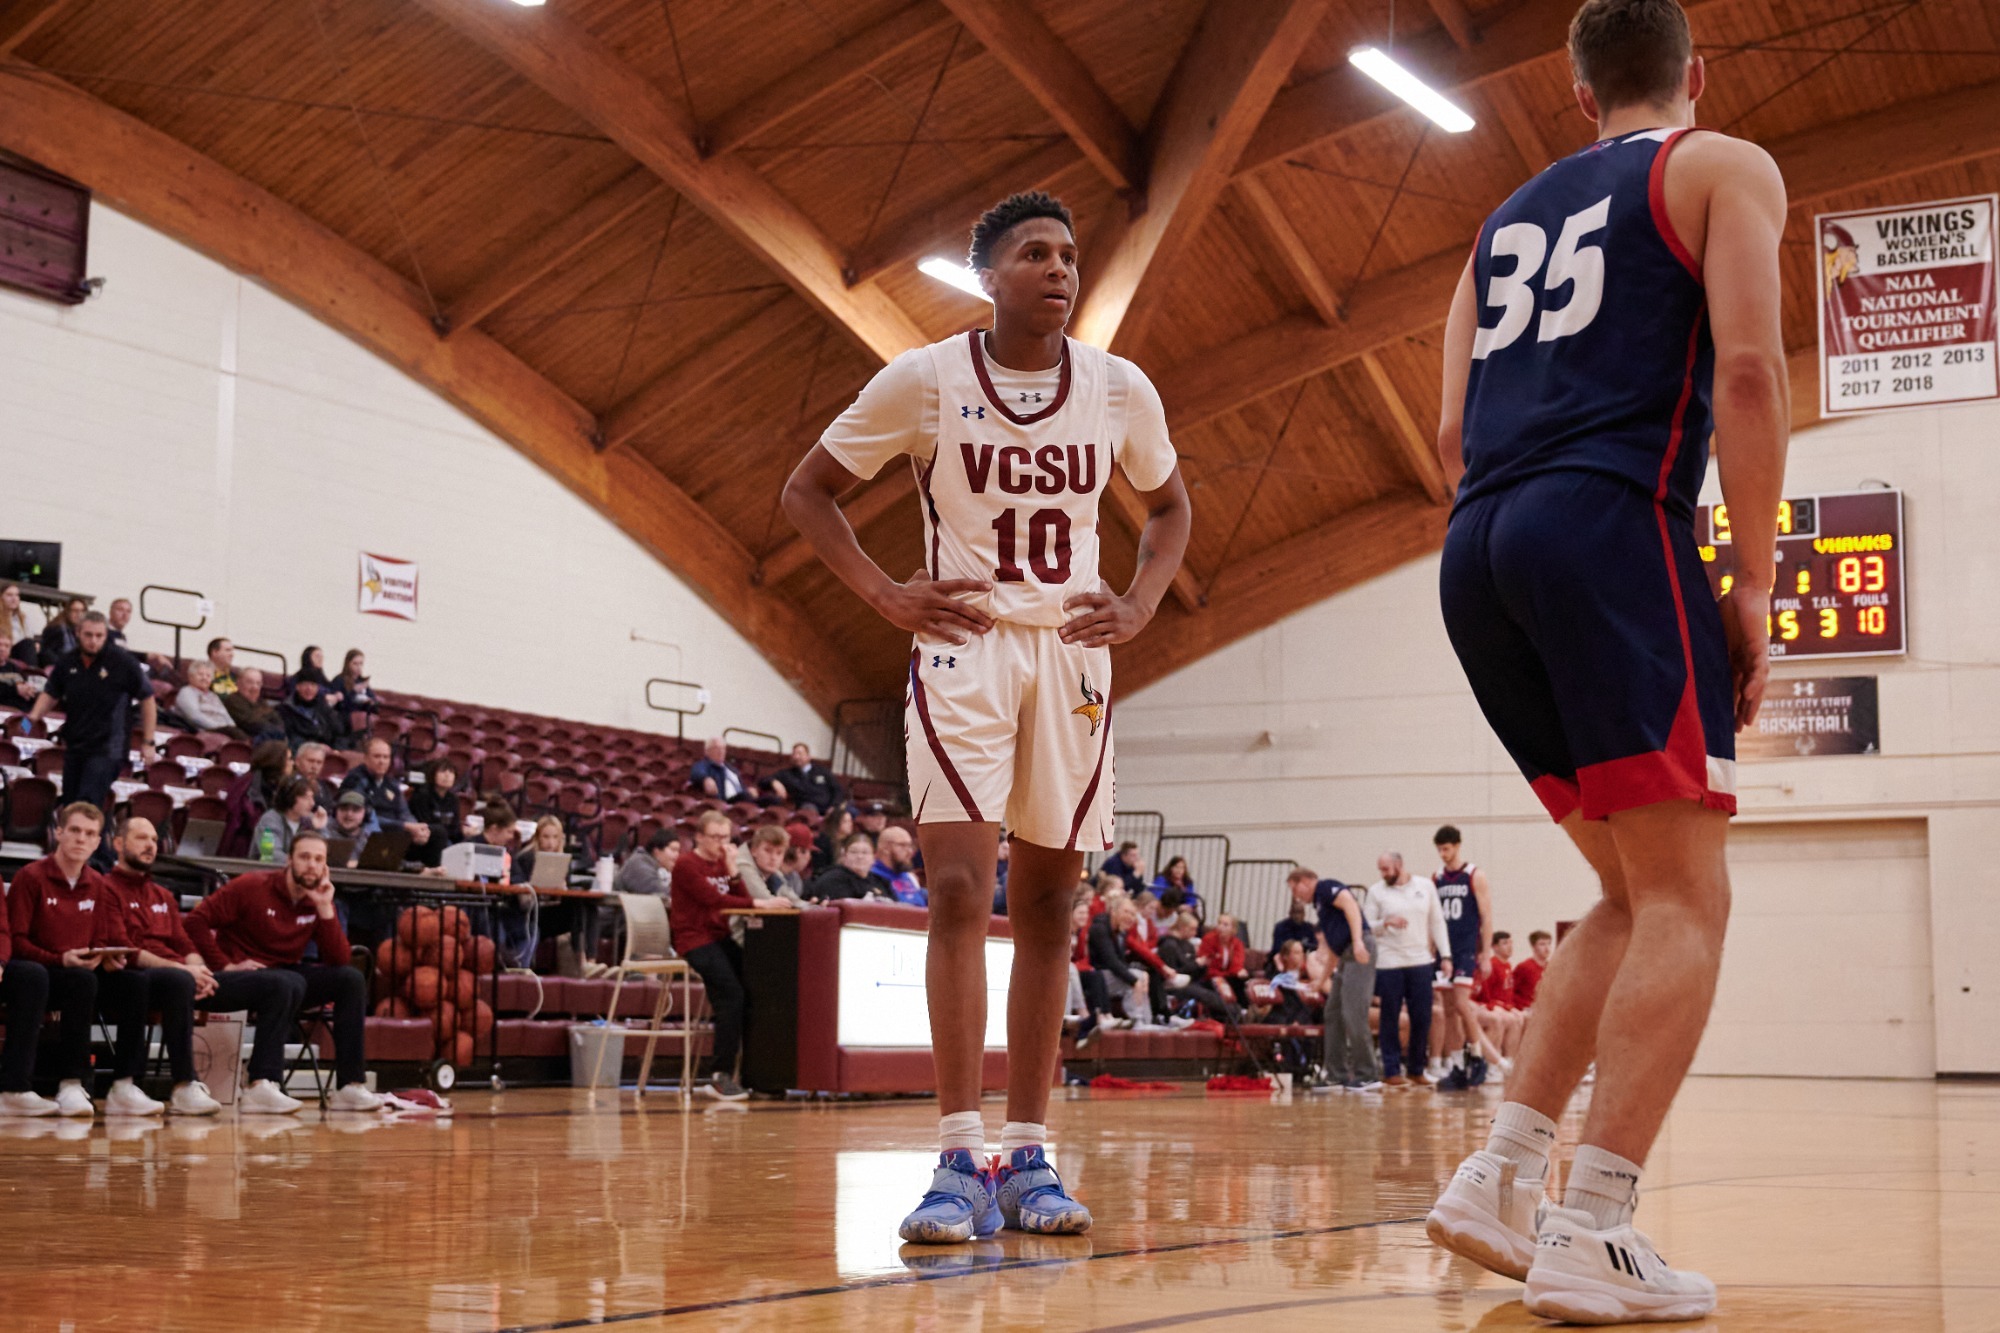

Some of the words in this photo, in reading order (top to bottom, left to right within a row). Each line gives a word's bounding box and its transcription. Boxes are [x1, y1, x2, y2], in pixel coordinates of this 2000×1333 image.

[1876, 209, 1975, 239] VIKINGS
[1886, 232, 1966, 250] WOMEN'S
[1877, 244, 1978, 267] BASKETBALL
[1471, 194, 1612, 360] 35
[1886, 273, 1936, 292] NAIA
[1861, 289, 1963, 312] NATIONAL
[1841, 304, 1983, 332] TOURNAMENT
[1858, 323, 1966, 349] QUALIFIER
[1841, 358, 1880, 375] 2011
[1891, 353, 1932, 370] 2012
[1943, 348, 1985, 365] 2013
[1841, 380, 1881, 397] 2017
[1892, 376, 1933, 393] 2018
[960, 443, 1096, 494] VCSU
[991, 508, 1072, 584] 10
[1838, 556, 1885, 593] 83
[1774, 598, 1802, 611] FOUL
[1853, 593, 1889, 606] FOULS
[1819, 608, 1838, 638] 3
[1857, 606, 1886, 634] 10
[1760, 714, 1852, 734] BASKETBALL
